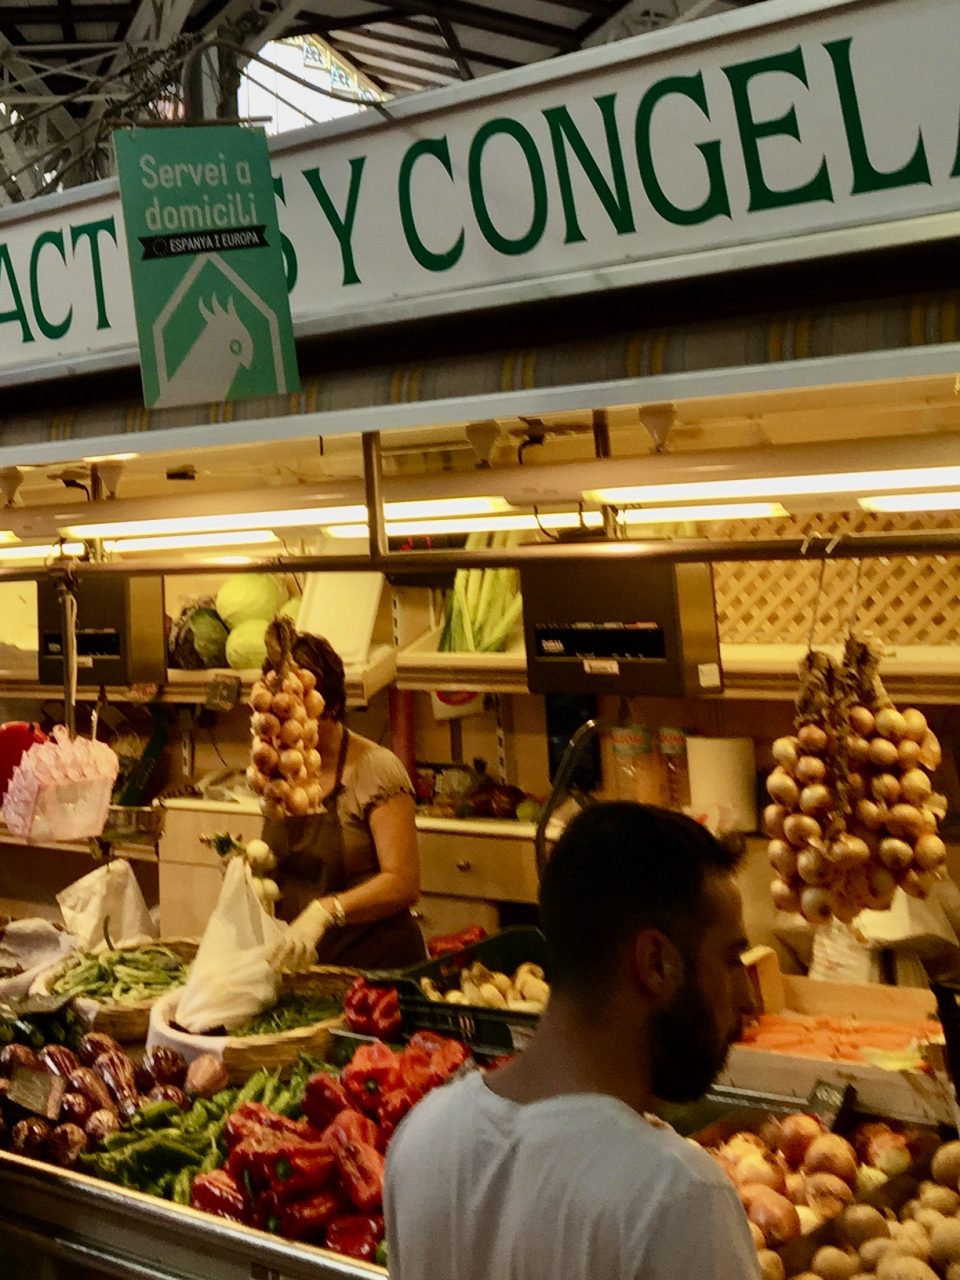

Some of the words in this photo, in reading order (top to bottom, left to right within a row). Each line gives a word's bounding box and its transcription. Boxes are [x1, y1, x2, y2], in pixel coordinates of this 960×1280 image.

[141, 153, 228, 189] Servei
[236, 161, 251, 185] a
[301, 156, 366, 287] Y
[397, 36, 960, 272] CONGEL
[146, 192, 258, 231] domicili
[170, 236, 213, 253] ESPANYA
[214, 235, 220, 248] I
[221, 231, 260, 247] EUROPA
